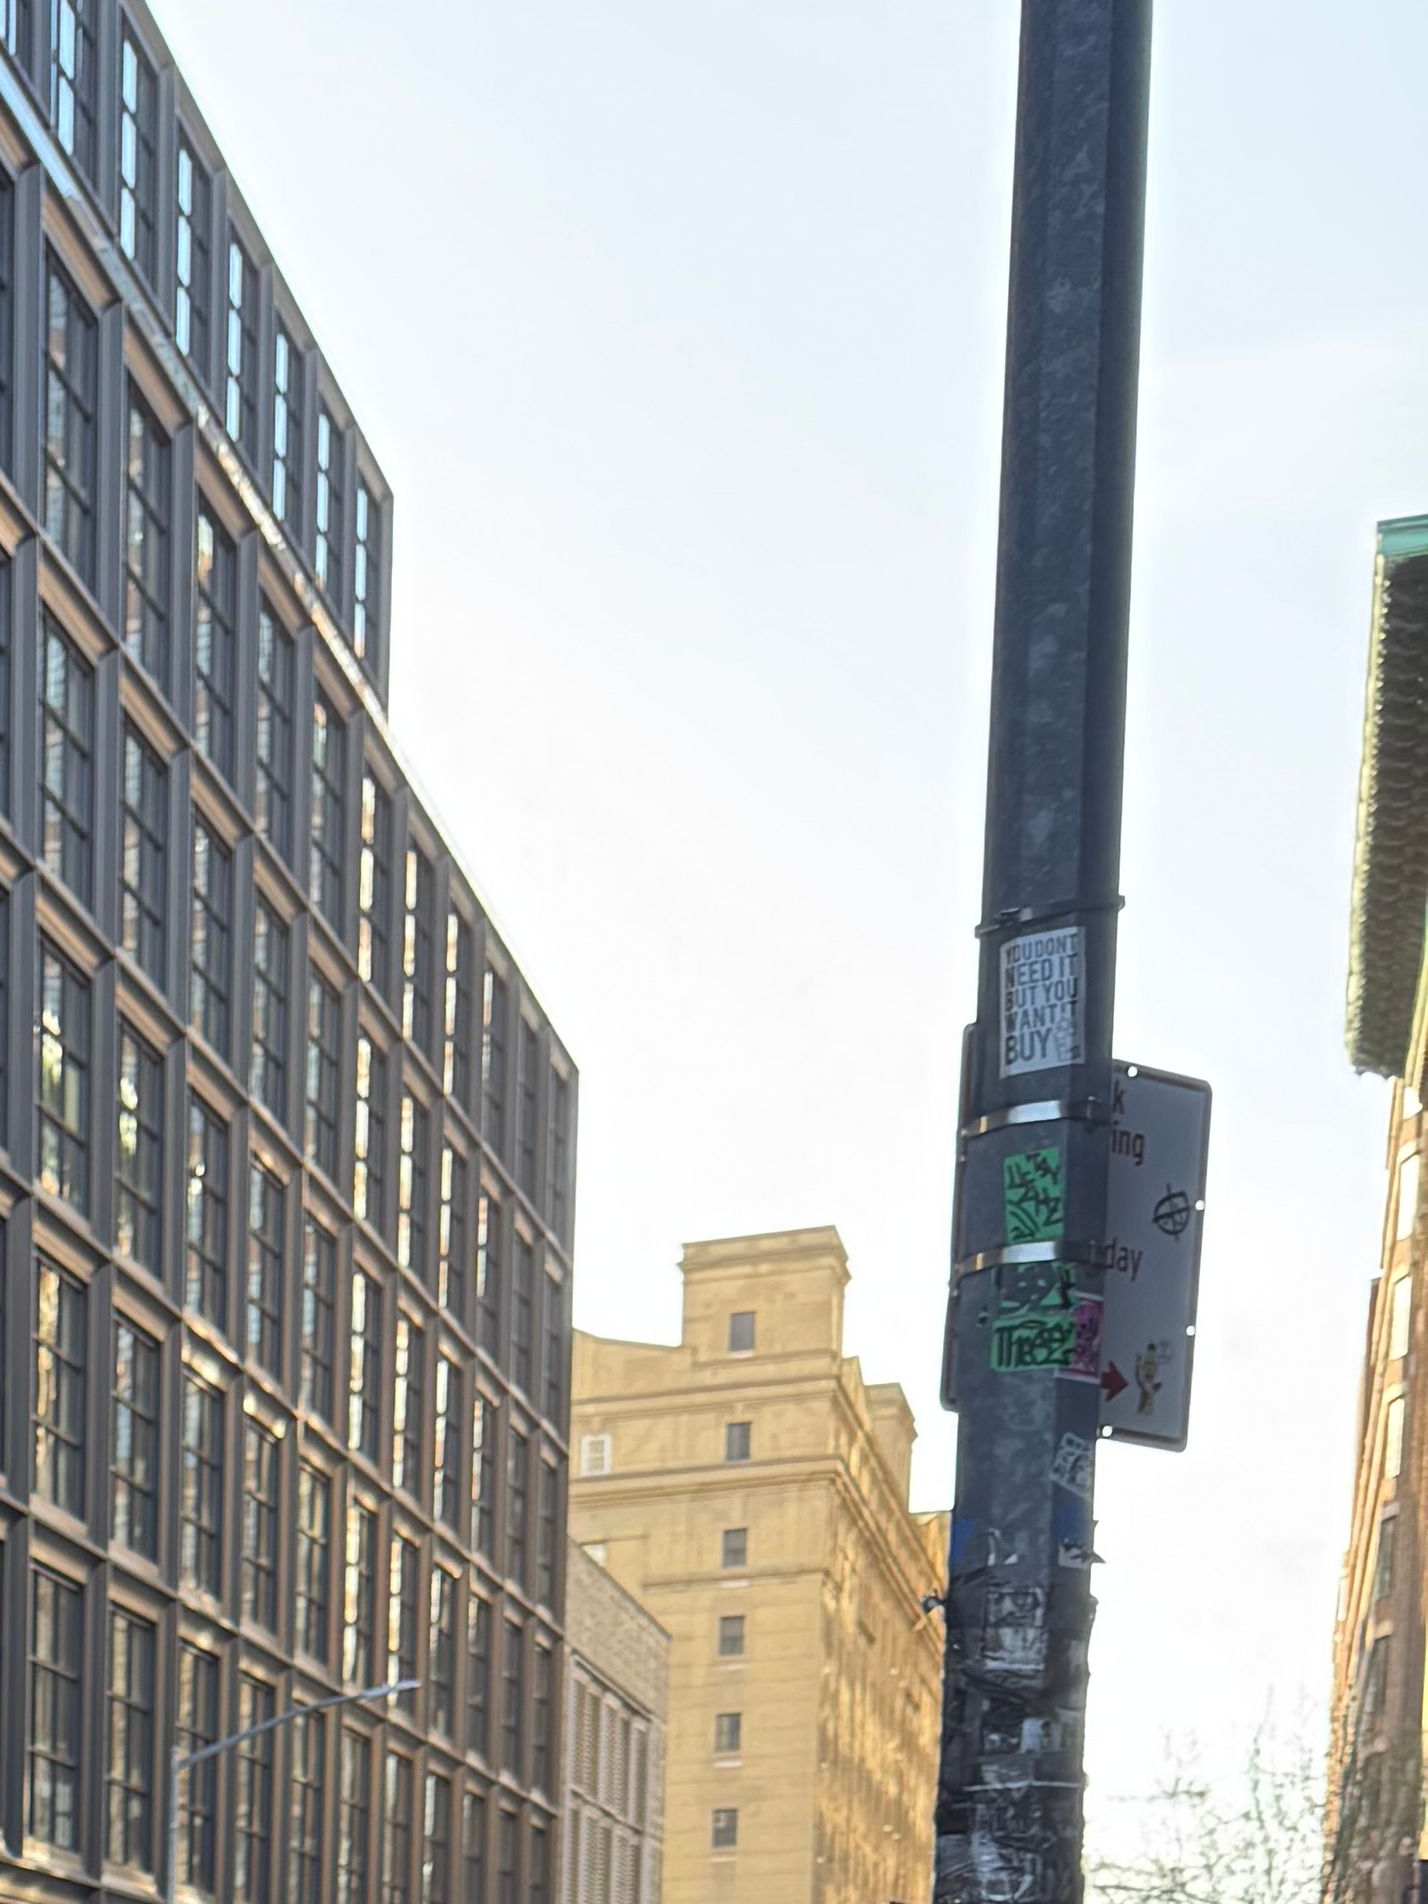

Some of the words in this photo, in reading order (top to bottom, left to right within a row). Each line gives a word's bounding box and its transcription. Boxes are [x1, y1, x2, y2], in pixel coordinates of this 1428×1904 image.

[1006, 943, 1032, 965] YOU
[1006, 958, 1053, 989] NEED
[1060, 953, 1077, 978] IT
[1006, 986, 1038, 1012] BUT
[1043, 977, 1078, 1003] YOU
[1005, 1003, 1057, 1034] WANT
[1006, 1028, 1052, 1066] BUY
